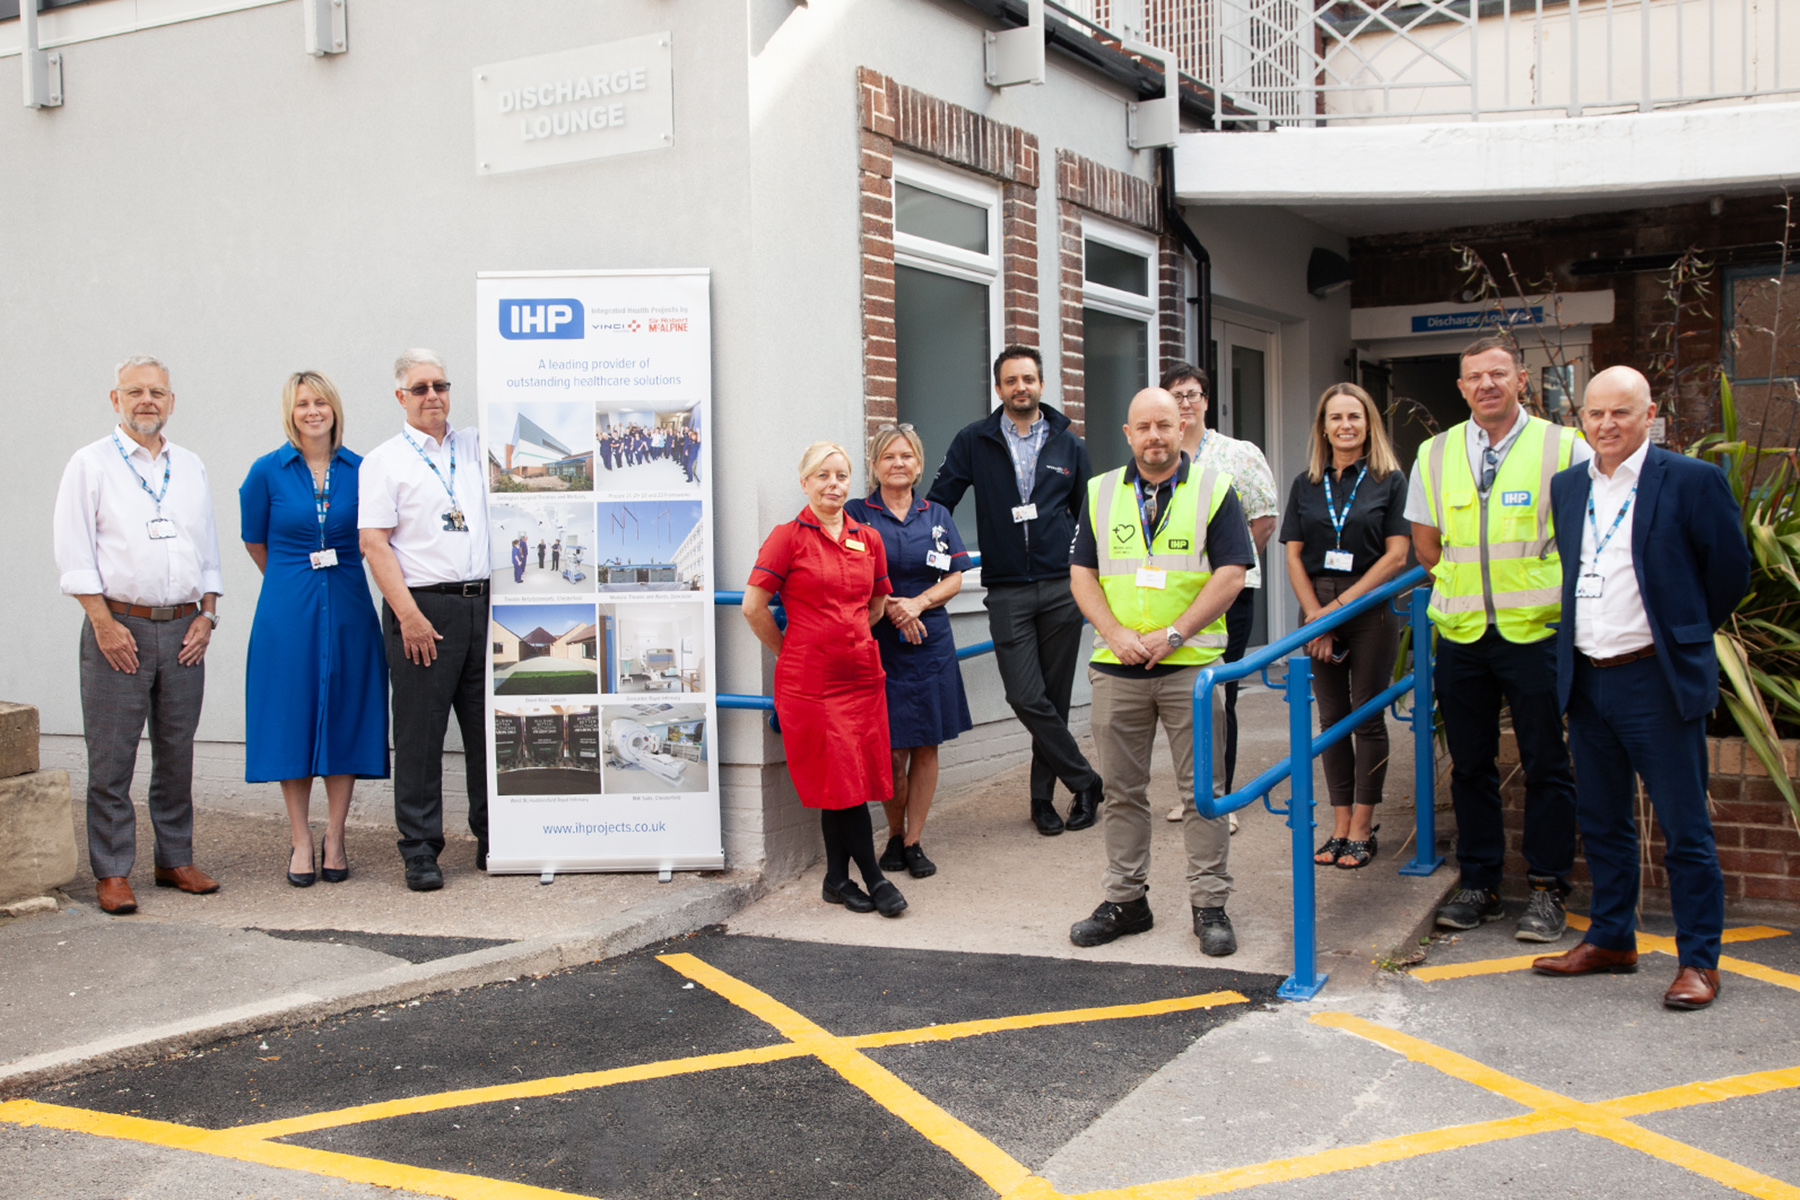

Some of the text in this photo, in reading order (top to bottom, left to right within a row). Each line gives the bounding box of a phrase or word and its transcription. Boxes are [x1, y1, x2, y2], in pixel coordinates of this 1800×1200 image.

[498, 66, 647, 113] DISCHARGE
[520, 103, 625, 141] LOUNGE
[651, 306, 678, 314] Projects
[511, 304, 573, 333] IHP
[538, 357, 650, 372] A leading provider of
[506, 374, 682, 389] outstanding healthcare solutions
[1505, 493, 1528, 503] IHP
[1171, 540, 1187, 549] IHP
[542, 821, 666, 835] www.ihprojects.co.uk
